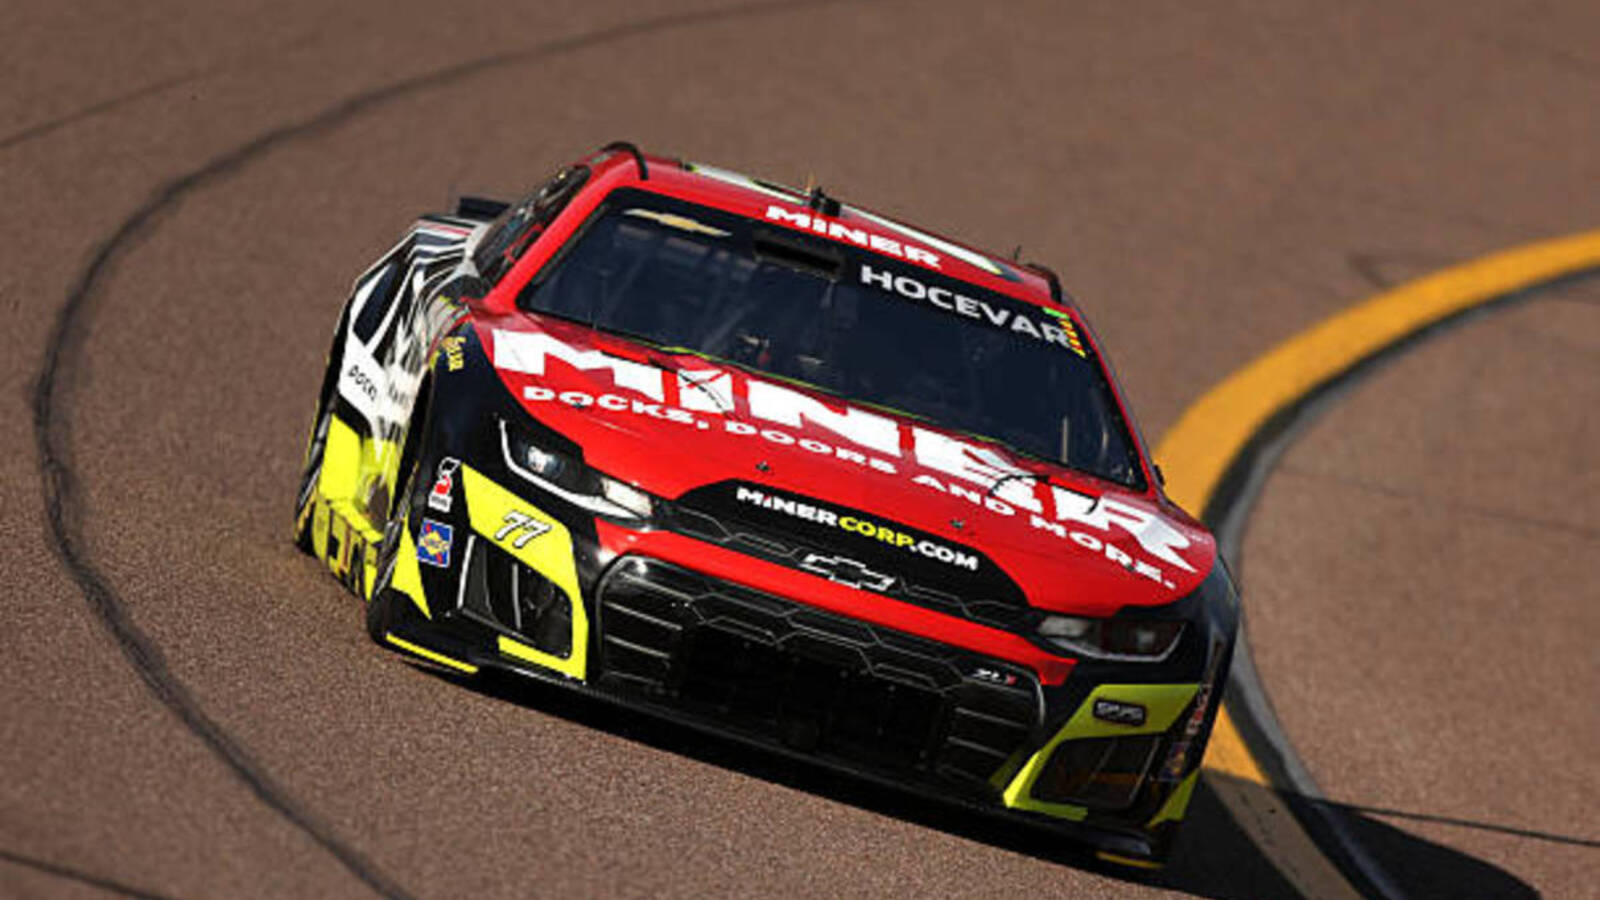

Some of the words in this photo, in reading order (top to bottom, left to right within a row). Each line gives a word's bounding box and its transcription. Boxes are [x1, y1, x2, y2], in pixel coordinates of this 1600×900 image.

[860, 265, 1072, 349] HOCEVAR
[494, 509, 553, 550] 77
[523, 386, 710, 430] DOCKS,
[725, 419, 898, 475] DOORS
[911, 475, 1017, 517] AND
[1030, 515, 1177, 590] MORE.
